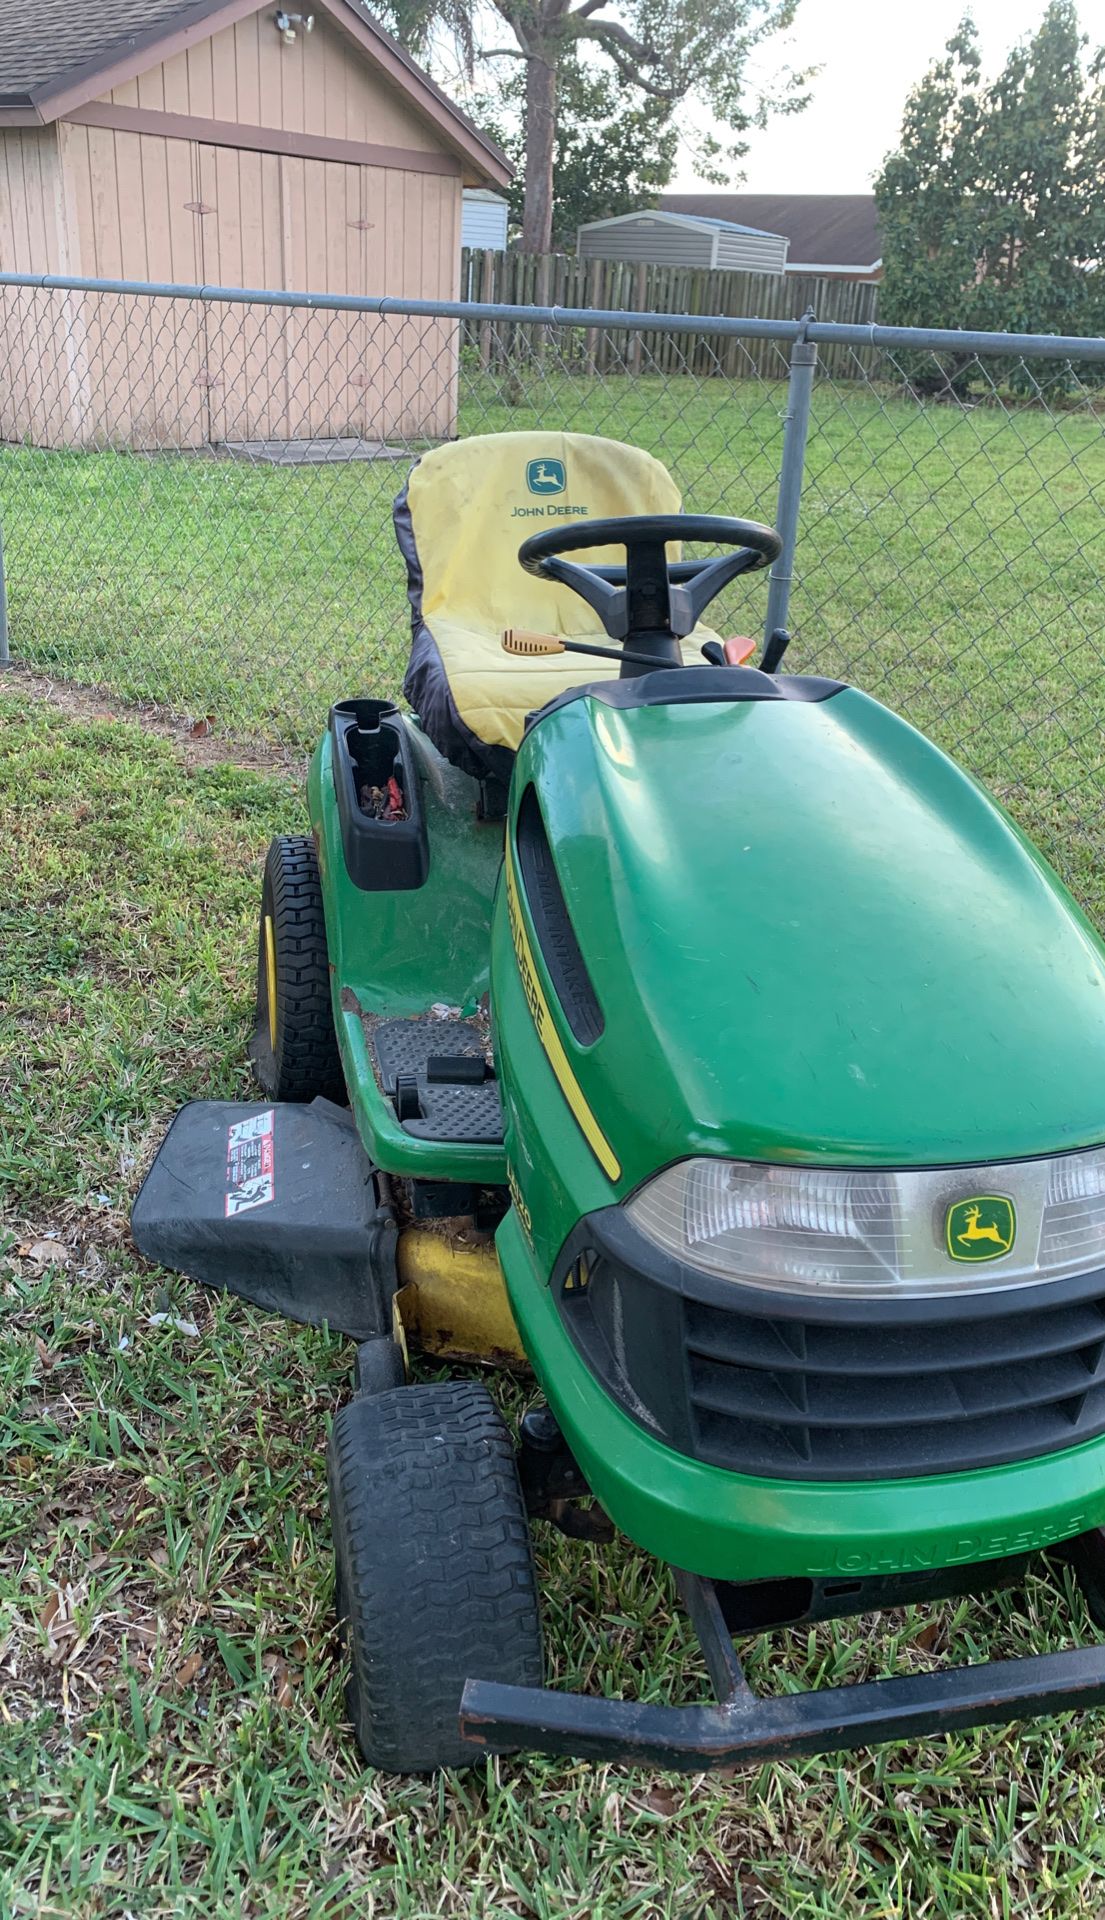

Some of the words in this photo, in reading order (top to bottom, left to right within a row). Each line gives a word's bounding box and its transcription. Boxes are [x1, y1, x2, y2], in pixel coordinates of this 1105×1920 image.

[510, 506, 545, 517] JOHN
[547, 505, 589, 516] DEERE
[548, 926, 586, 1006] INTAKE
[806, 1546, 938, 1572] JOHN
[945, 1514, 1086, 1563] DEERE
